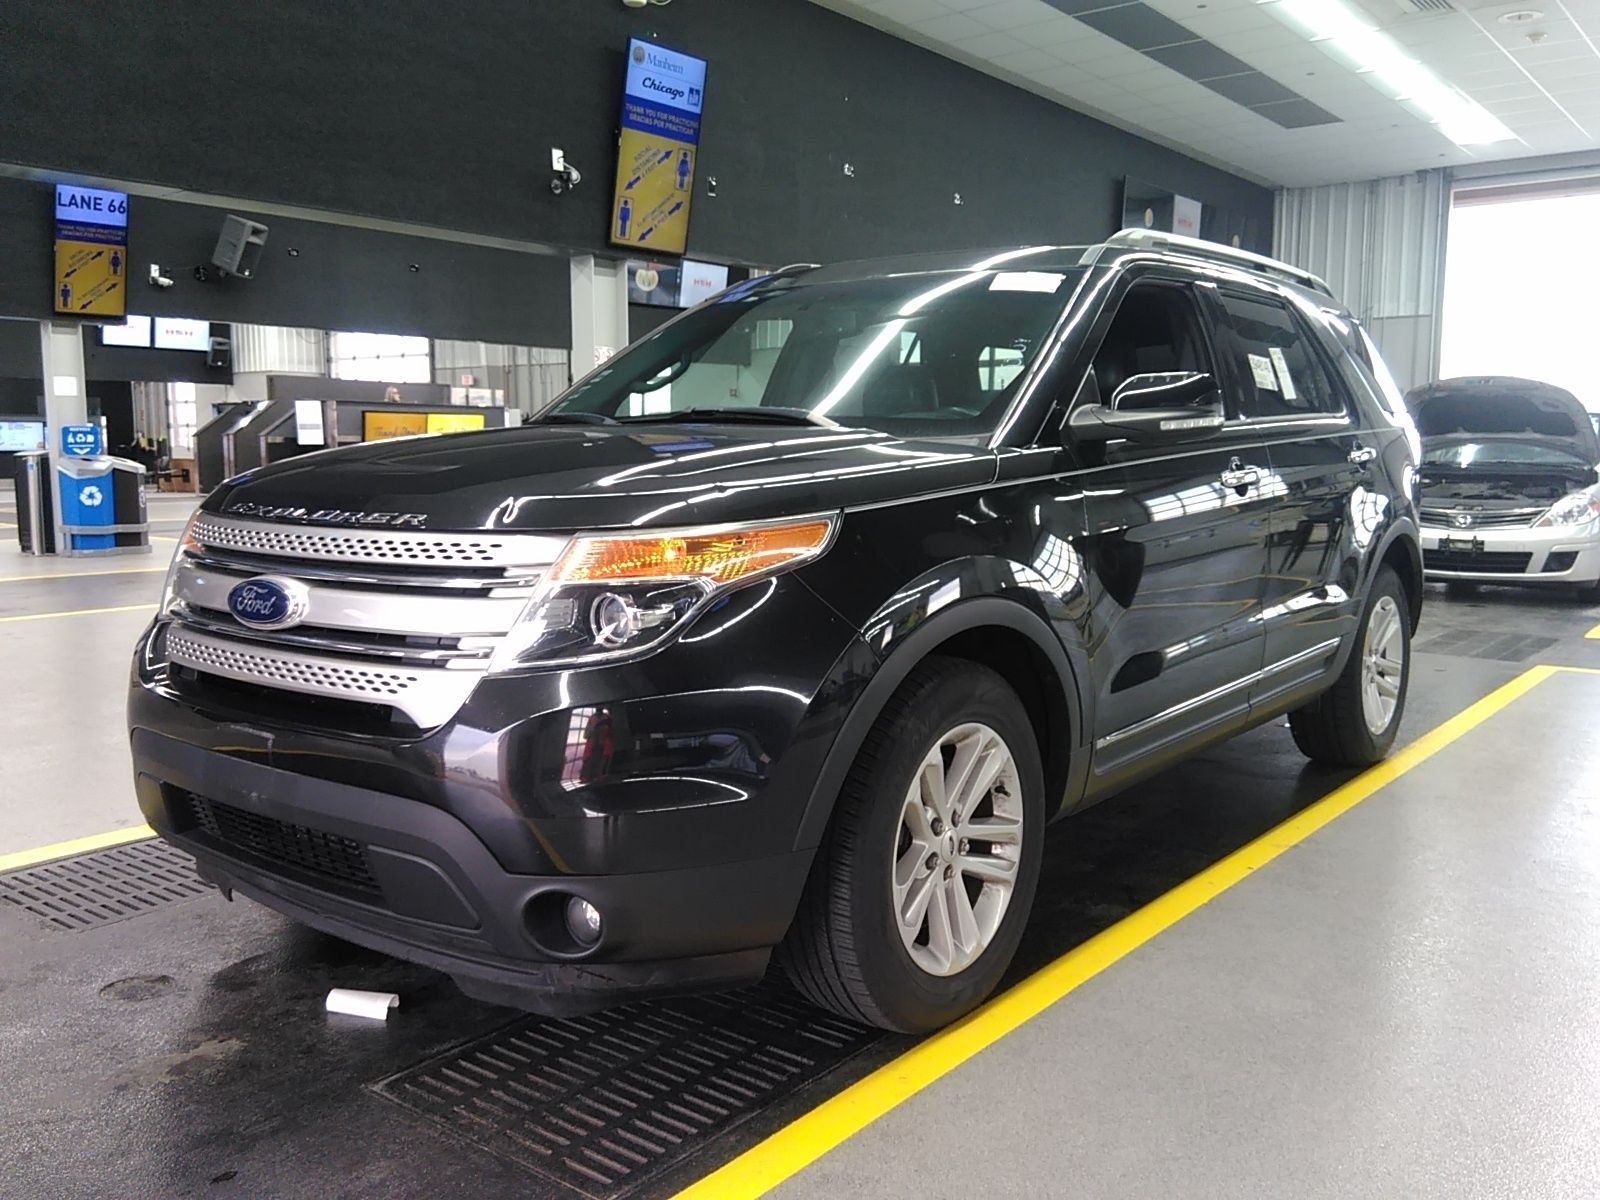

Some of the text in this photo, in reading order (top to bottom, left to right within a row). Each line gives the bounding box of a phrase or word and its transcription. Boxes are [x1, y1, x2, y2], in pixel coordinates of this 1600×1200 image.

[646, 53, 684, 75] Manheim
[642, 77, 685, 100] Chicago
[625, 103, 645, 114] THANK
[645, 108, 657, 117] YOU
[657, 111, 668, 120] FOR
[57, 192, 127, 214] LANE 66
[228, 502, 428, 529] EXPLORER
[236, 585, 277, 616] Ford
